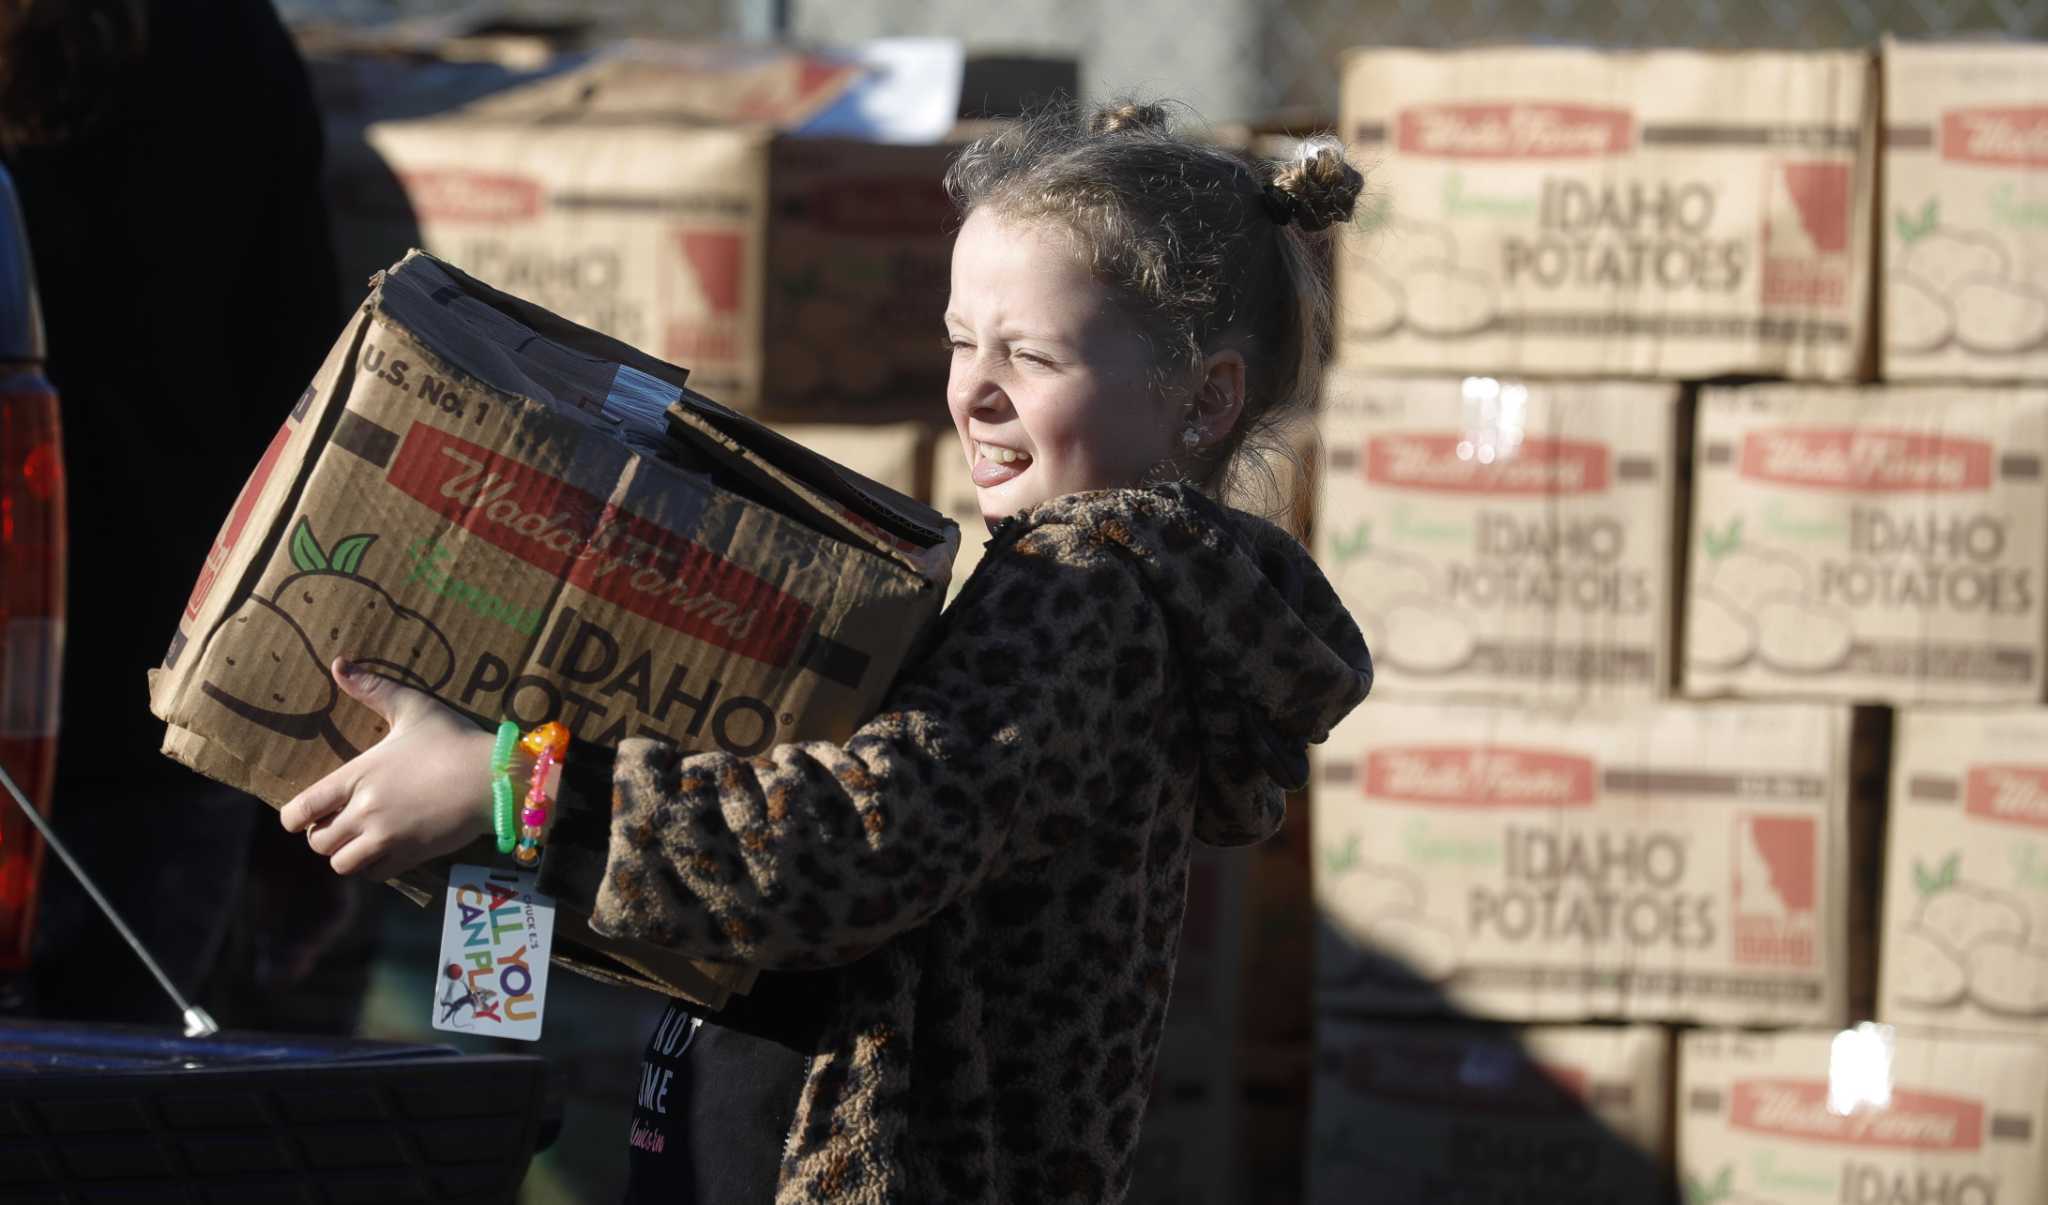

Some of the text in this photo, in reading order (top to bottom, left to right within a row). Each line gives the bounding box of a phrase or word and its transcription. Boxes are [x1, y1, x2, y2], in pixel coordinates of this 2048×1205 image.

[1539, 174, 1714, 232] IDAHO
[1502, 235, 1746, 294] POTATOES
[362, 343, 490, 427] U.S. No. 1
[440, 446, 596, 561] Wada
[1849, 506, 2009, 561] IDAHO
[1475, 509, 1624, 565] IDAHO
[1447, 562, 1653, 617] POTATOES
[1820, 560, 2034, 616] POTATOES
[461, 650, 680, 750] POTA
[1504, 823, 1688, 889] IDAHO
[455, 883, 490, 948] CAN
[1468, 884, 1718, 949] POTATOES
[485, 881, 538, 1022] ALL YOU
